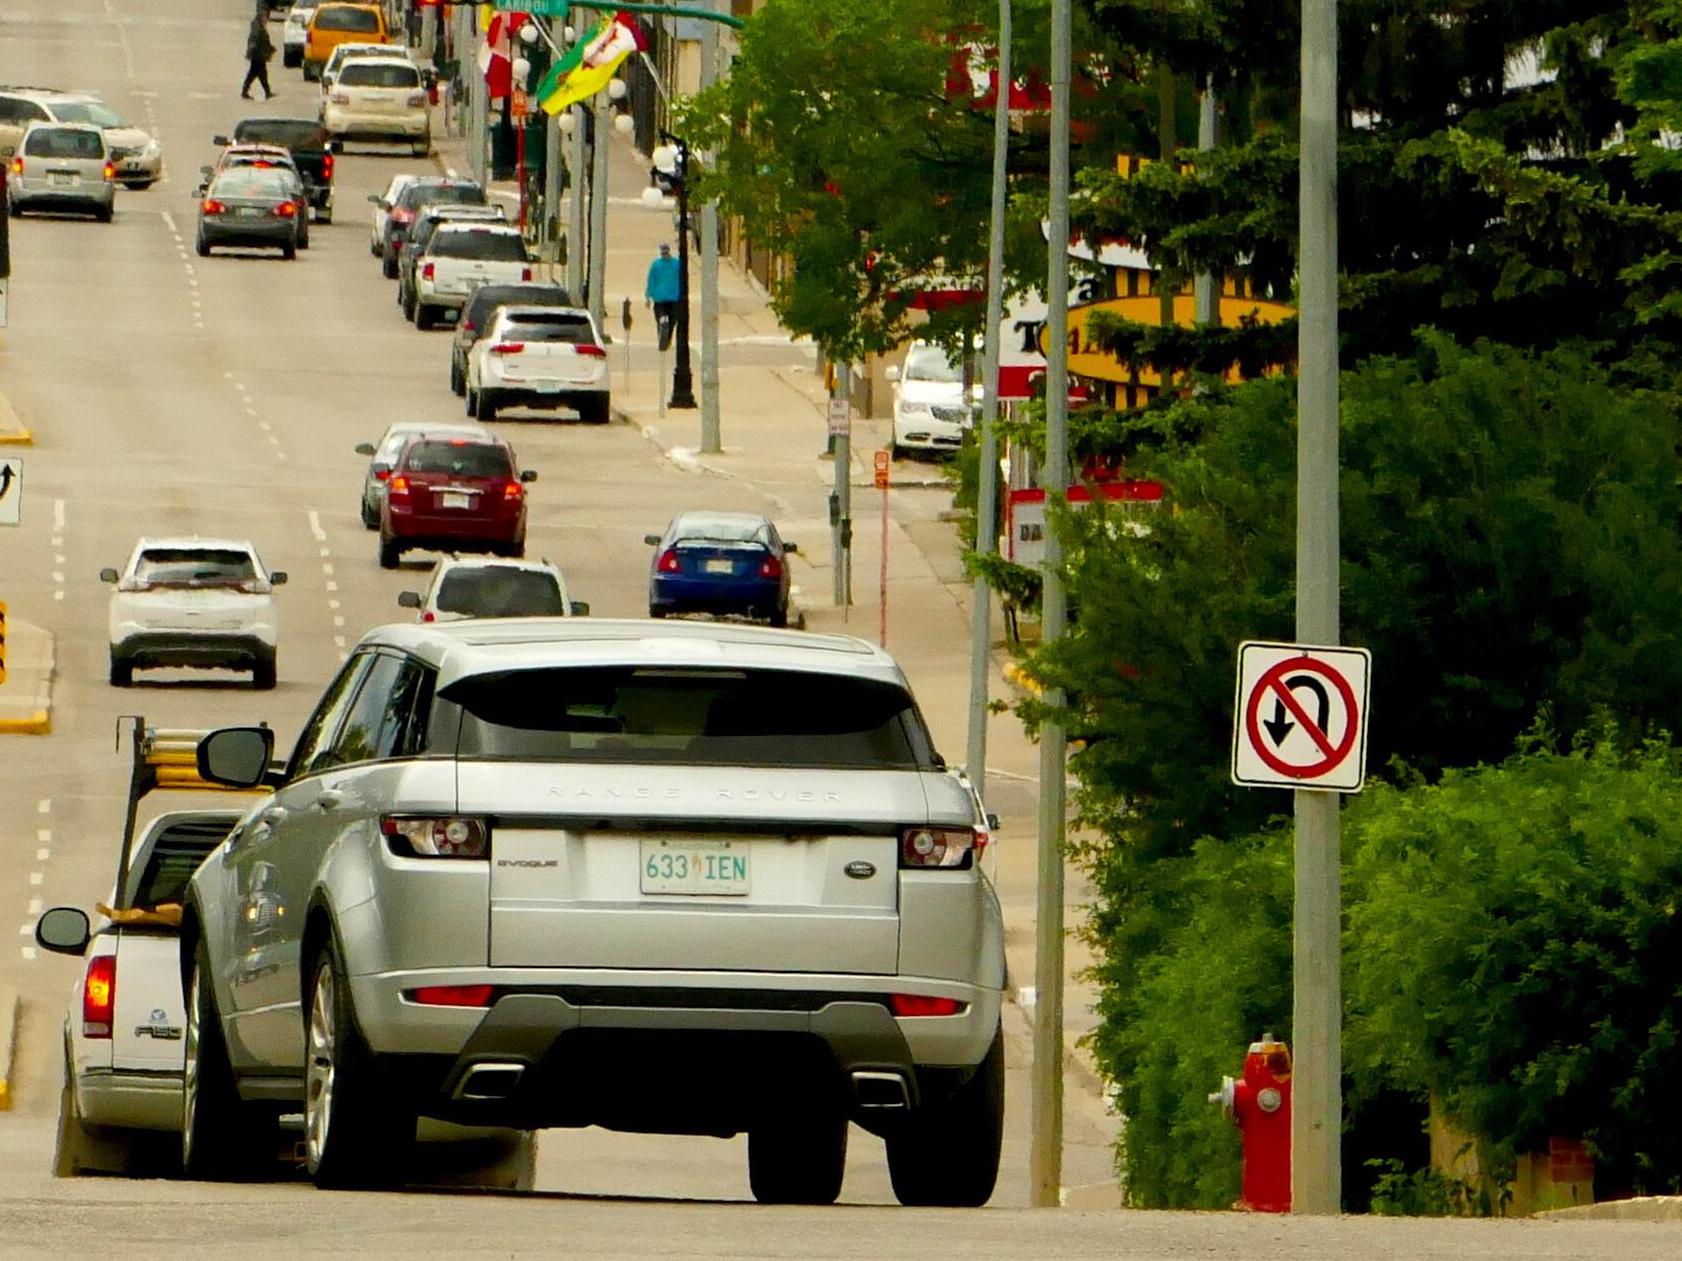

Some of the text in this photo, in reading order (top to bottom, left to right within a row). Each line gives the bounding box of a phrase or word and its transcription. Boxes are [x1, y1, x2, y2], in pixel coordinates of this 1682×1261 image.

[545, 785, 843, 803] RANGE ROVER
[497, 859, 559, 868] EVOQUE
[646, 854, 746, 880] 633 IEN
